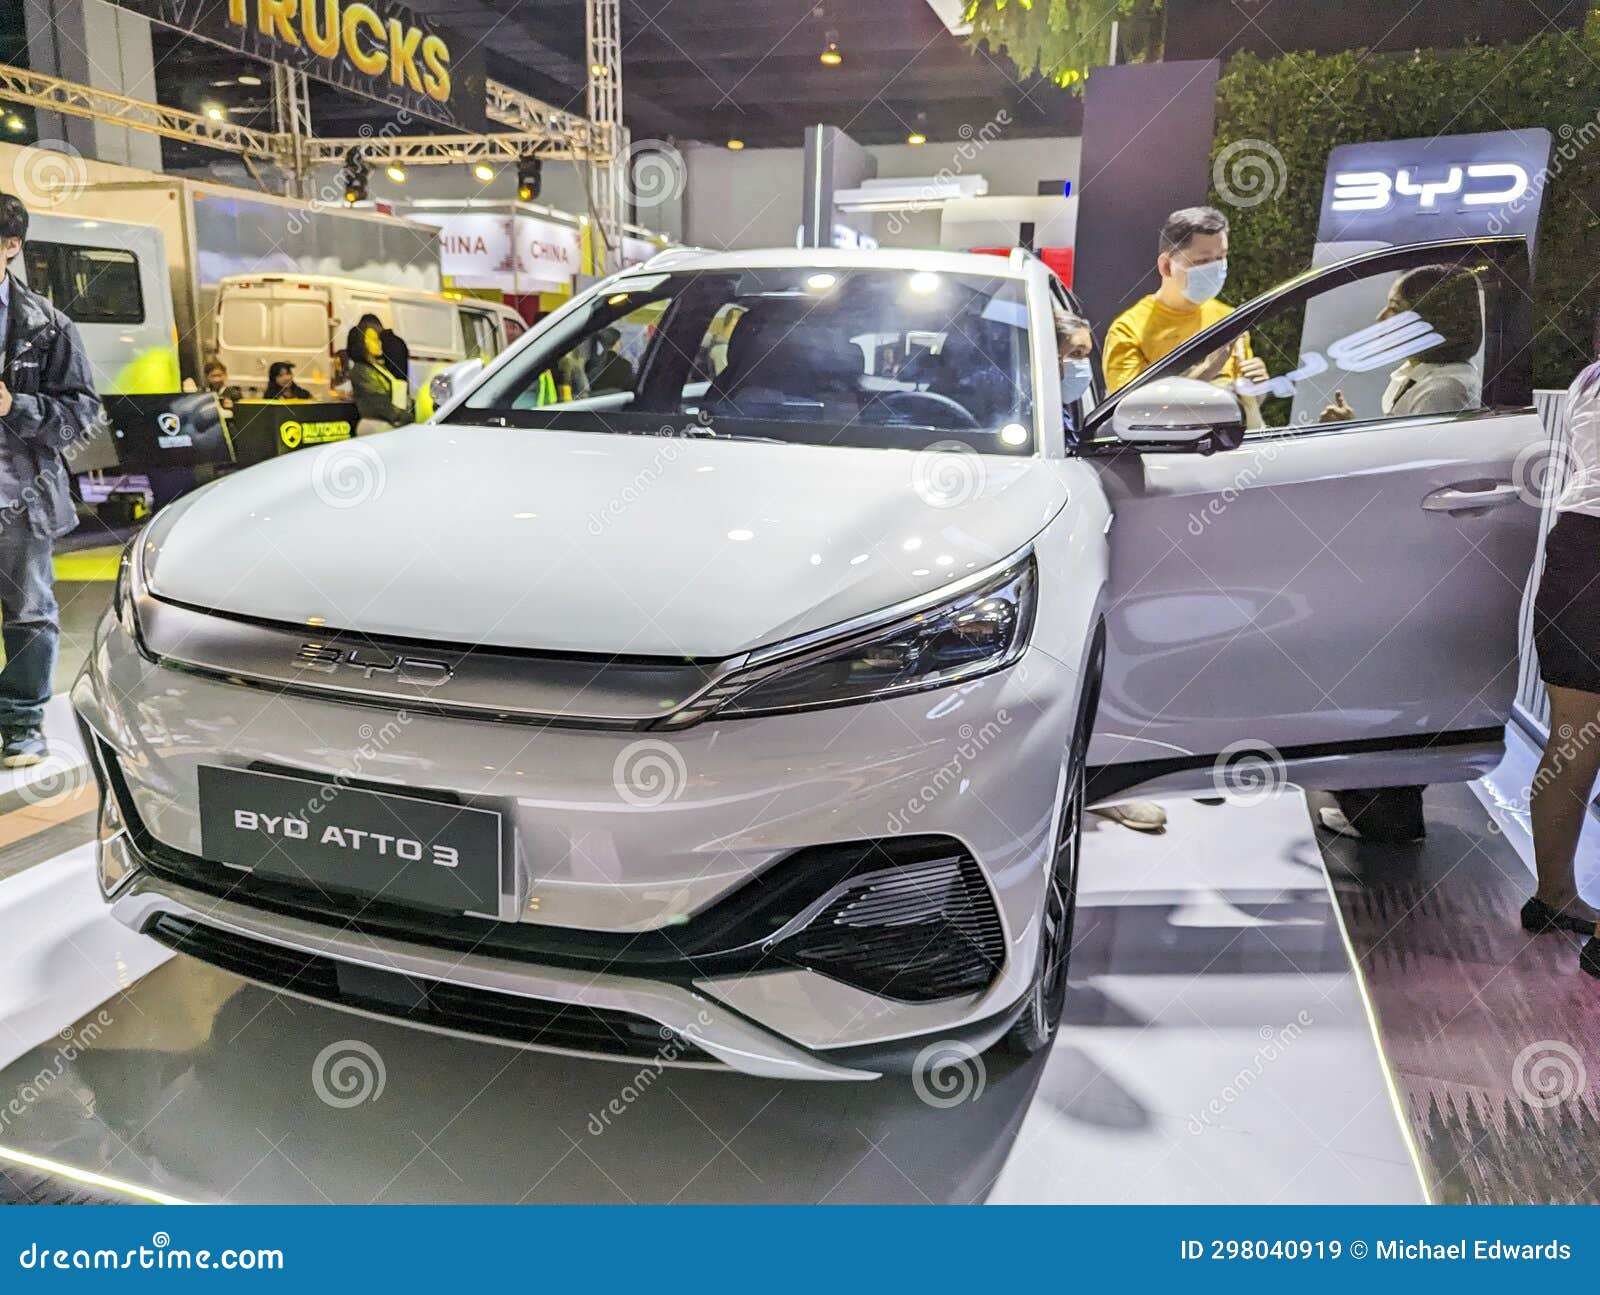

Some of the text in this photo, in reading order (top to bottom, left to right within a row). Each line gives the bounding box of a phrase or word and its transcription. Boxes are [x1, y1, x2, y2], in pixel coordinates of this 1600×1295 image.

[1331, 163, 1528, 210] BYD
[439, 235, 488, 255] HINA
[530, 239, 569, 264] CHINA
[290, 643, 454, 686] BYD
[234, 809, 459, 868] BYD ATTO 3
